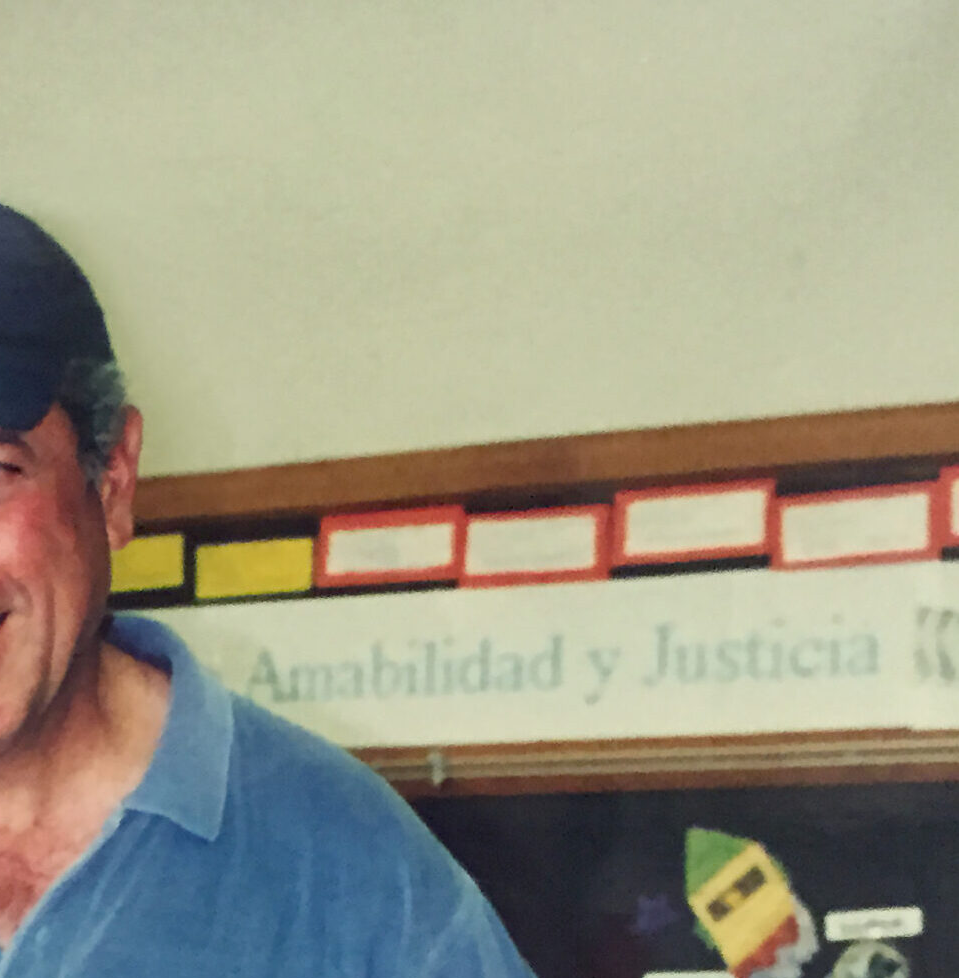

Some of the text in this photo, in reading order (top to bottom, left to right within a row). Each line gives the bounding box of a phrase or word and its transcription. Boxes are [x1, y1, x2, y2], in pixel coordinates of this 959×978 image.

[246, 612, 879, 705] Amabilidad y Justicia
